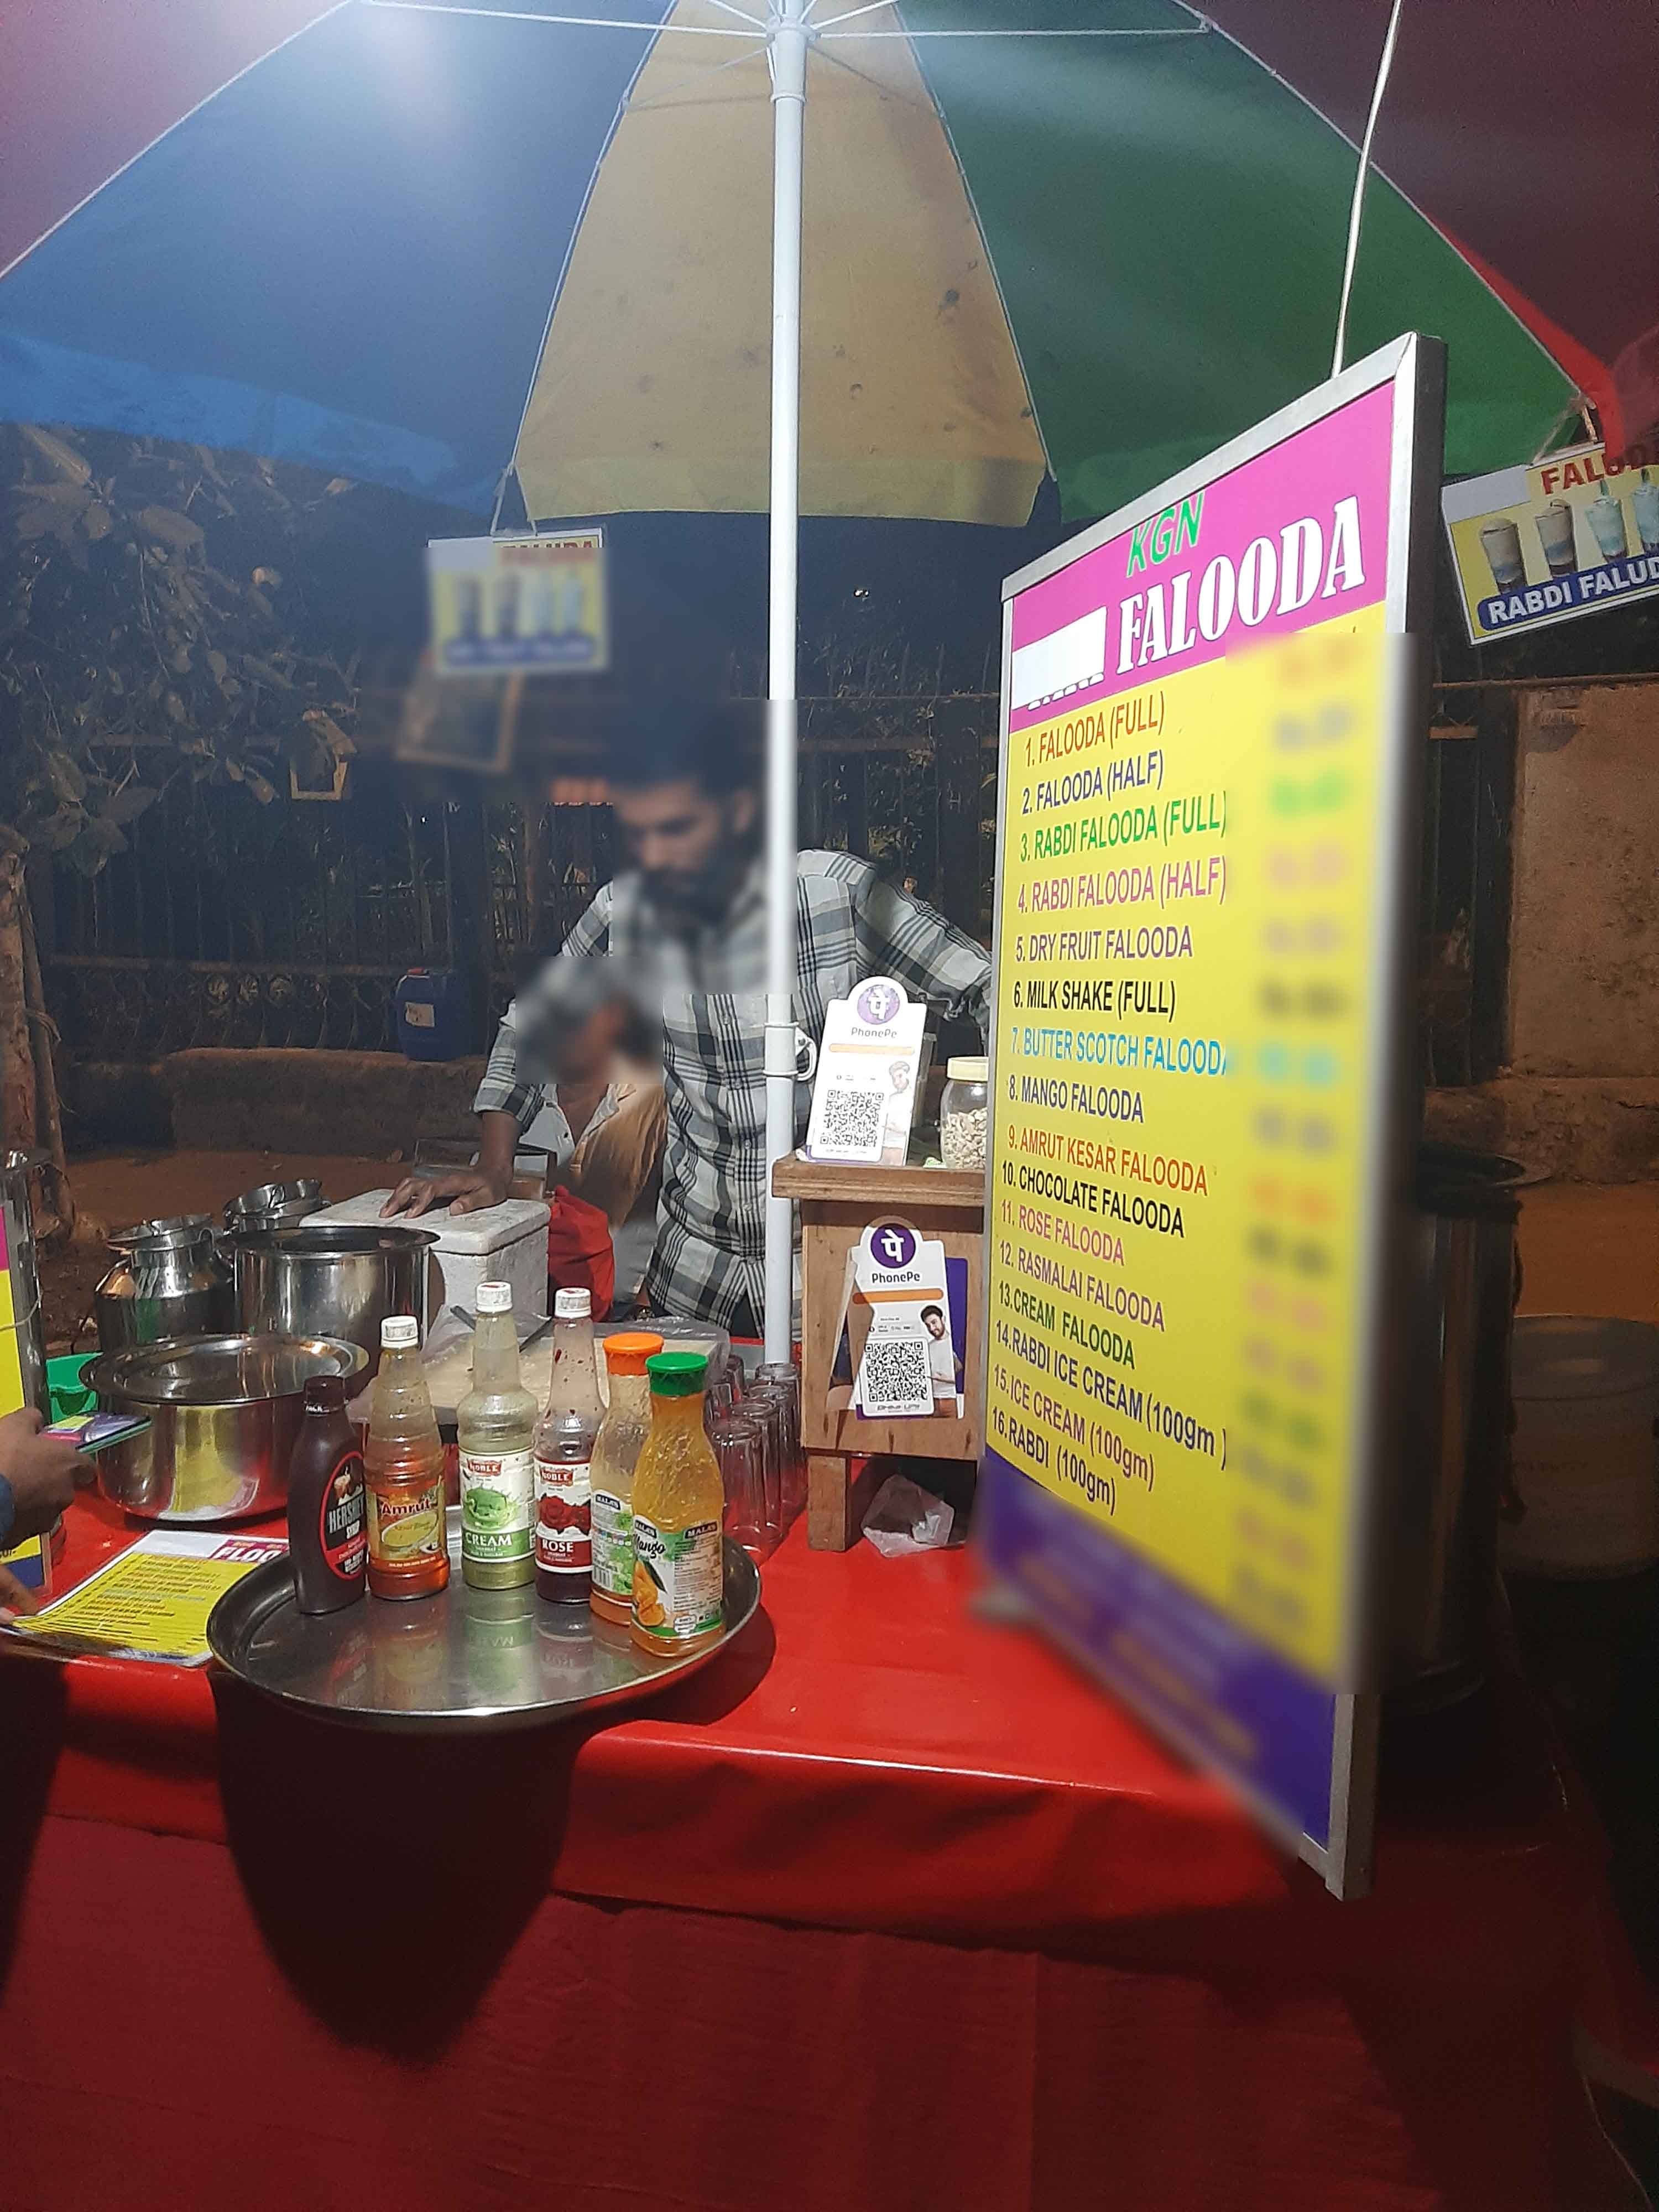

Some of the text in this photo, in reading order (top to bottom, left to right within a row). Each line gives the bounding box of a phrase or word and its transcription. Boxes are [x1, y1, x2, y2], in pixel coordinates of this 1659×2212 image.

[1127, 492, 1204, 578] KGN
[1116, 495, 1366, 676] FALOODA
[1488, 581, 1573, 624] RABDI
[1039, 712, 1105, 763] FALOODA
[1110, 691, 1165, 749] (FULL)
[1037, 767, 1103, 811] FALOODA
[1107, 749, 1163, 801] (HALF)
[1035, 822, 1076, 859] RABDI
[1080, 805, 1158, 852] FALOODA
[1164, 791, 1225, 847] (FULL)
[1032, 877, 1074, 912] RABDI
[1078, 867, 1155, 907] FALOODA
[1160, 855, 1225, 909] (HALF)
[1030, 933, 1056, 961] DRY
[1060, 931, 1102, 960] FRUIT
[1105, 926, 1193, 959] FALOODA
[1027, 981, 1058, 1009] MILK
[1062, 981, 1113, 1011] SHAKE
[1118, 981, 1176, 1022] (FULL)
[851, 1027, 898, 1039] PhonePe
[1024, 1027, 1072, 1060] BUTTER
[1077, 1032, 1138, 1067] SCOTCH
[1144, 1037, 1225, 1076] FALOOD
[1021, 1076, 1067, 1110] MANGO
[1072, 1083, 1144, 1123] FALOODA
[1020, 1128, 1065, 1161] AMRUT
[1067, 1138, 1116, 1175] KESAR
[1121, 1150, 1208, 1197] FALOODA
[1003, 1160, 1185, 1238] 10. CHOCOLATE FALOODA
[1019, 1204, 1051, 1240] ROSE
[1055, 1218, 1124, 1266] FALOODA
[872, 1271, 921, 1284] PhonePe
[1018, 1247, 1082, 1298] RASMALAI
[1087, 1275, 1165, 1332] FALOODA
[1062, 1311, 1135, 1370] FALOODA
[1054, 1350, 1078, 1387] ICE
[1083, 1366, 1142, 1423] CREAM
[1033, 1391, 1085, 1445] CREAM
[1090, 1422, 1154, 1492] (100gm)
[382, 1498, 431, 1515] Amrut
[1057, 1445, 1115, 1516] (100gm)
[465, 1532, 512, 1547] CREAM
[542, 1538, 574, 1553] ROSE
